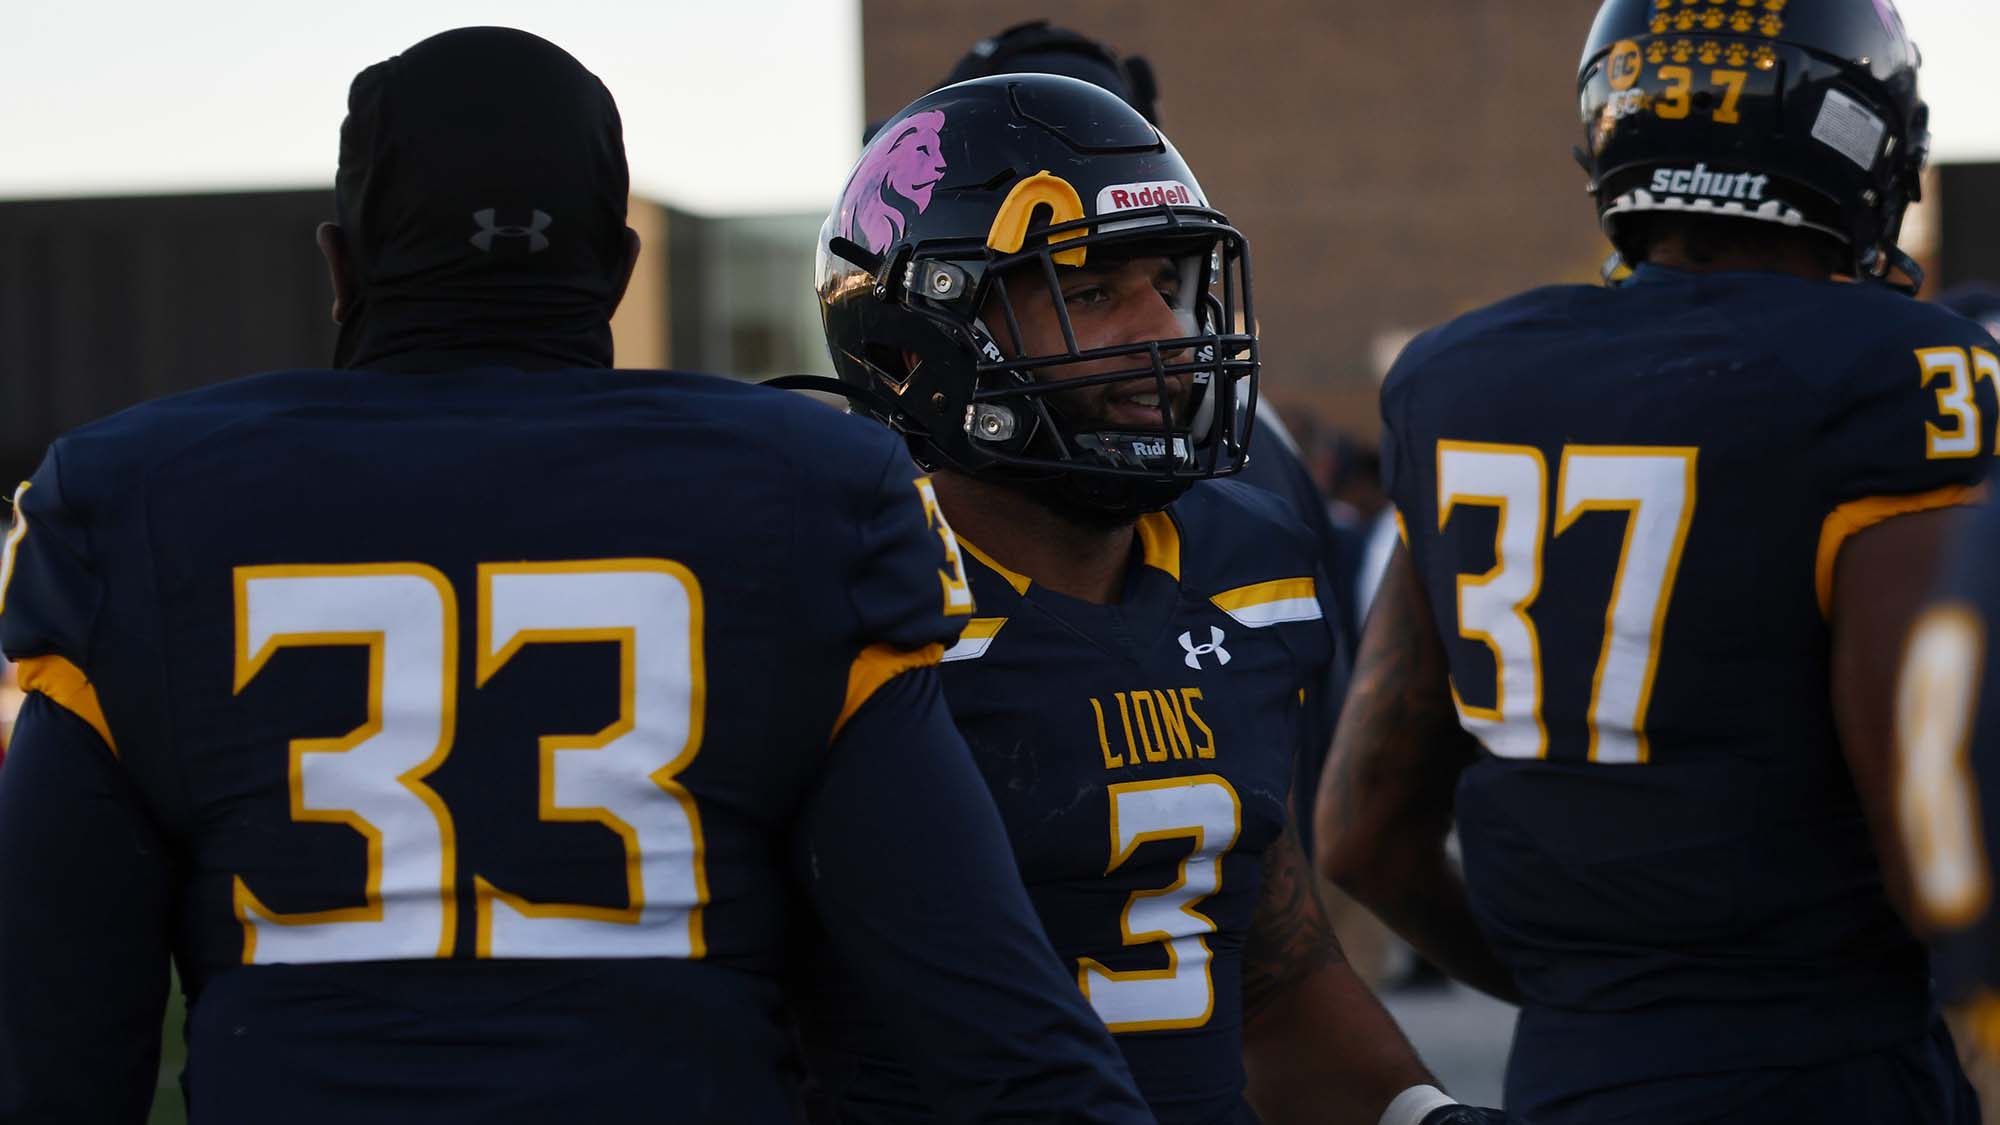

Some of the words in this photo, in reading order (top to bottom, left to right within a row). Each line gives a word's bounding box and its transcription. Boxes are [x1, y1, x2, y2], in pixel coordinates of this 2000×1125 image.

[1655, 65, 1749, 124] 37
[1111, 185, 1190, 209] Riddell
[1649, 162, 1768, 200] schutt
[1436, 439, 1699, 764] 37
[233, 558, 710, 964] 33
[1089, 687, 1216, 769] LIONS
[1077, 773, 1241, 1034] 3
